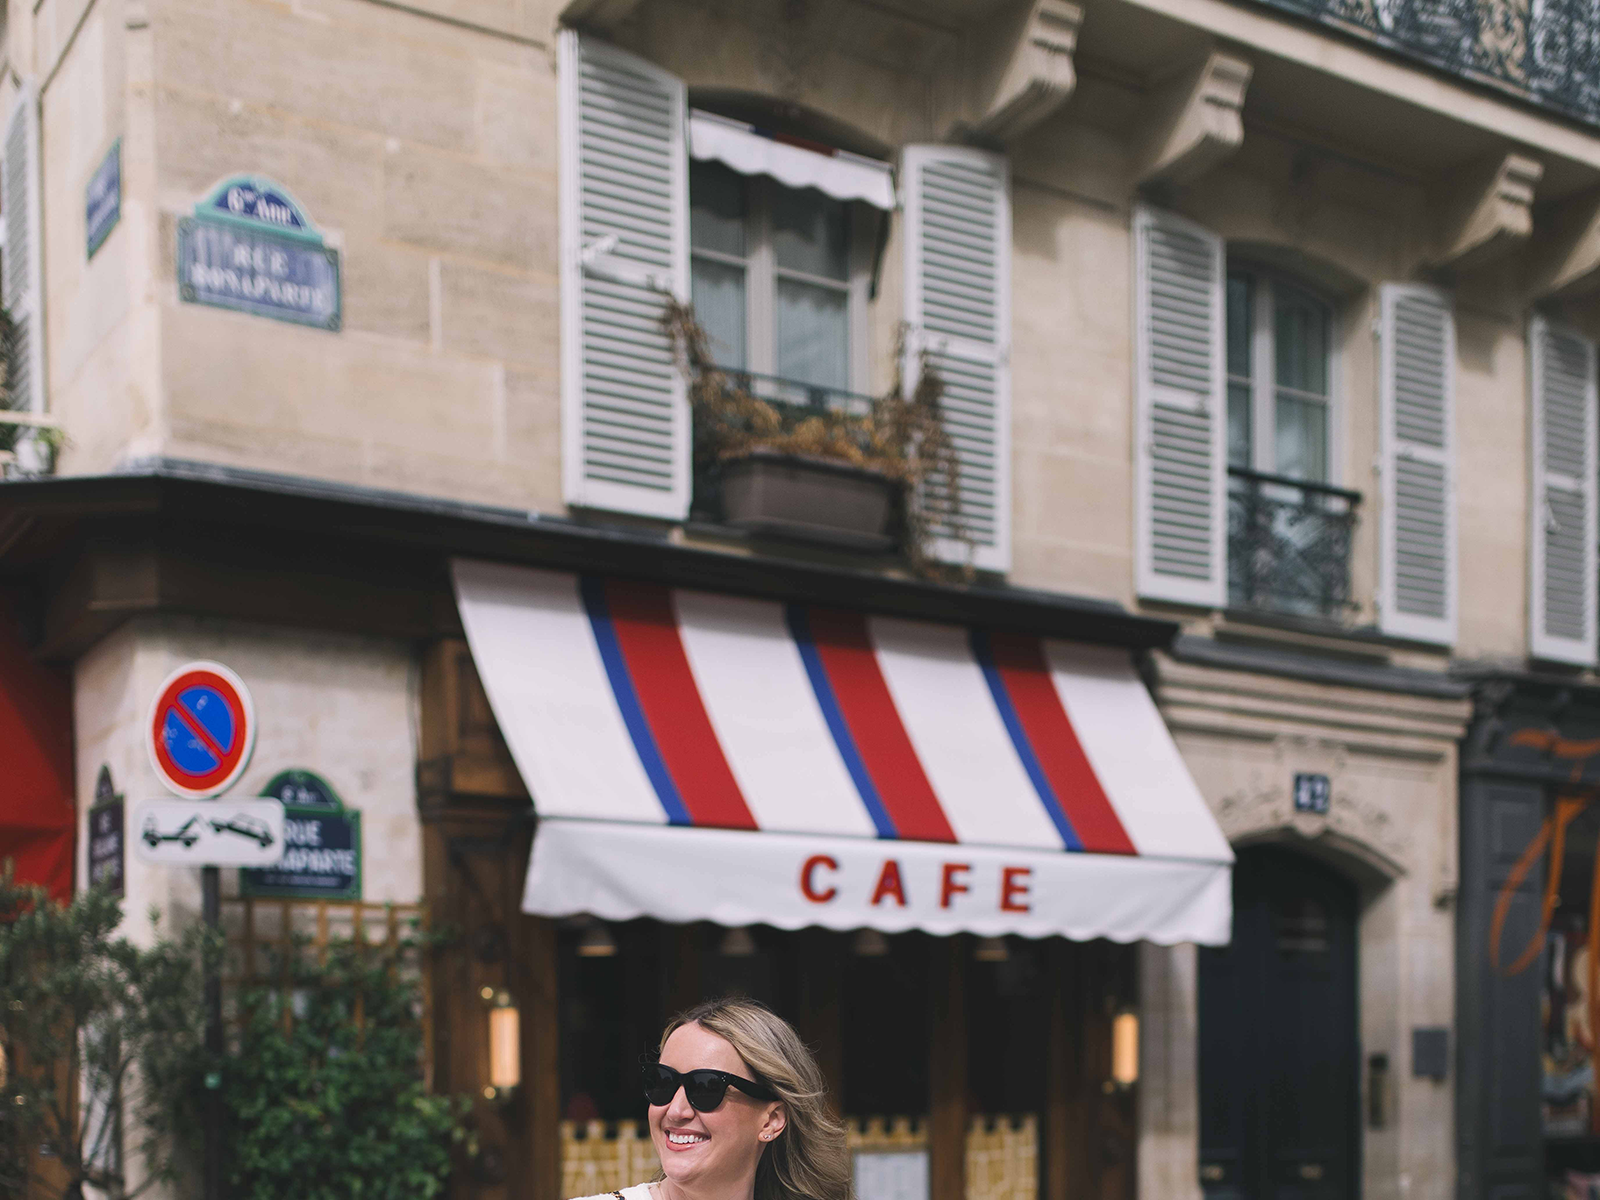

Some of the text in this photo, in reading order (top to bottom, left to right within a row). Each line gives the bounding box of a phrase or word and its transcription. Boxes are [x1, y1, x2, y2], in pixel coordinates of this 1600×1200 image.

[233, 243, 290, 279] RUE
[190, 262, 331, 313] BONAPARTE
[799, 854, 1031, 912] CAFE
